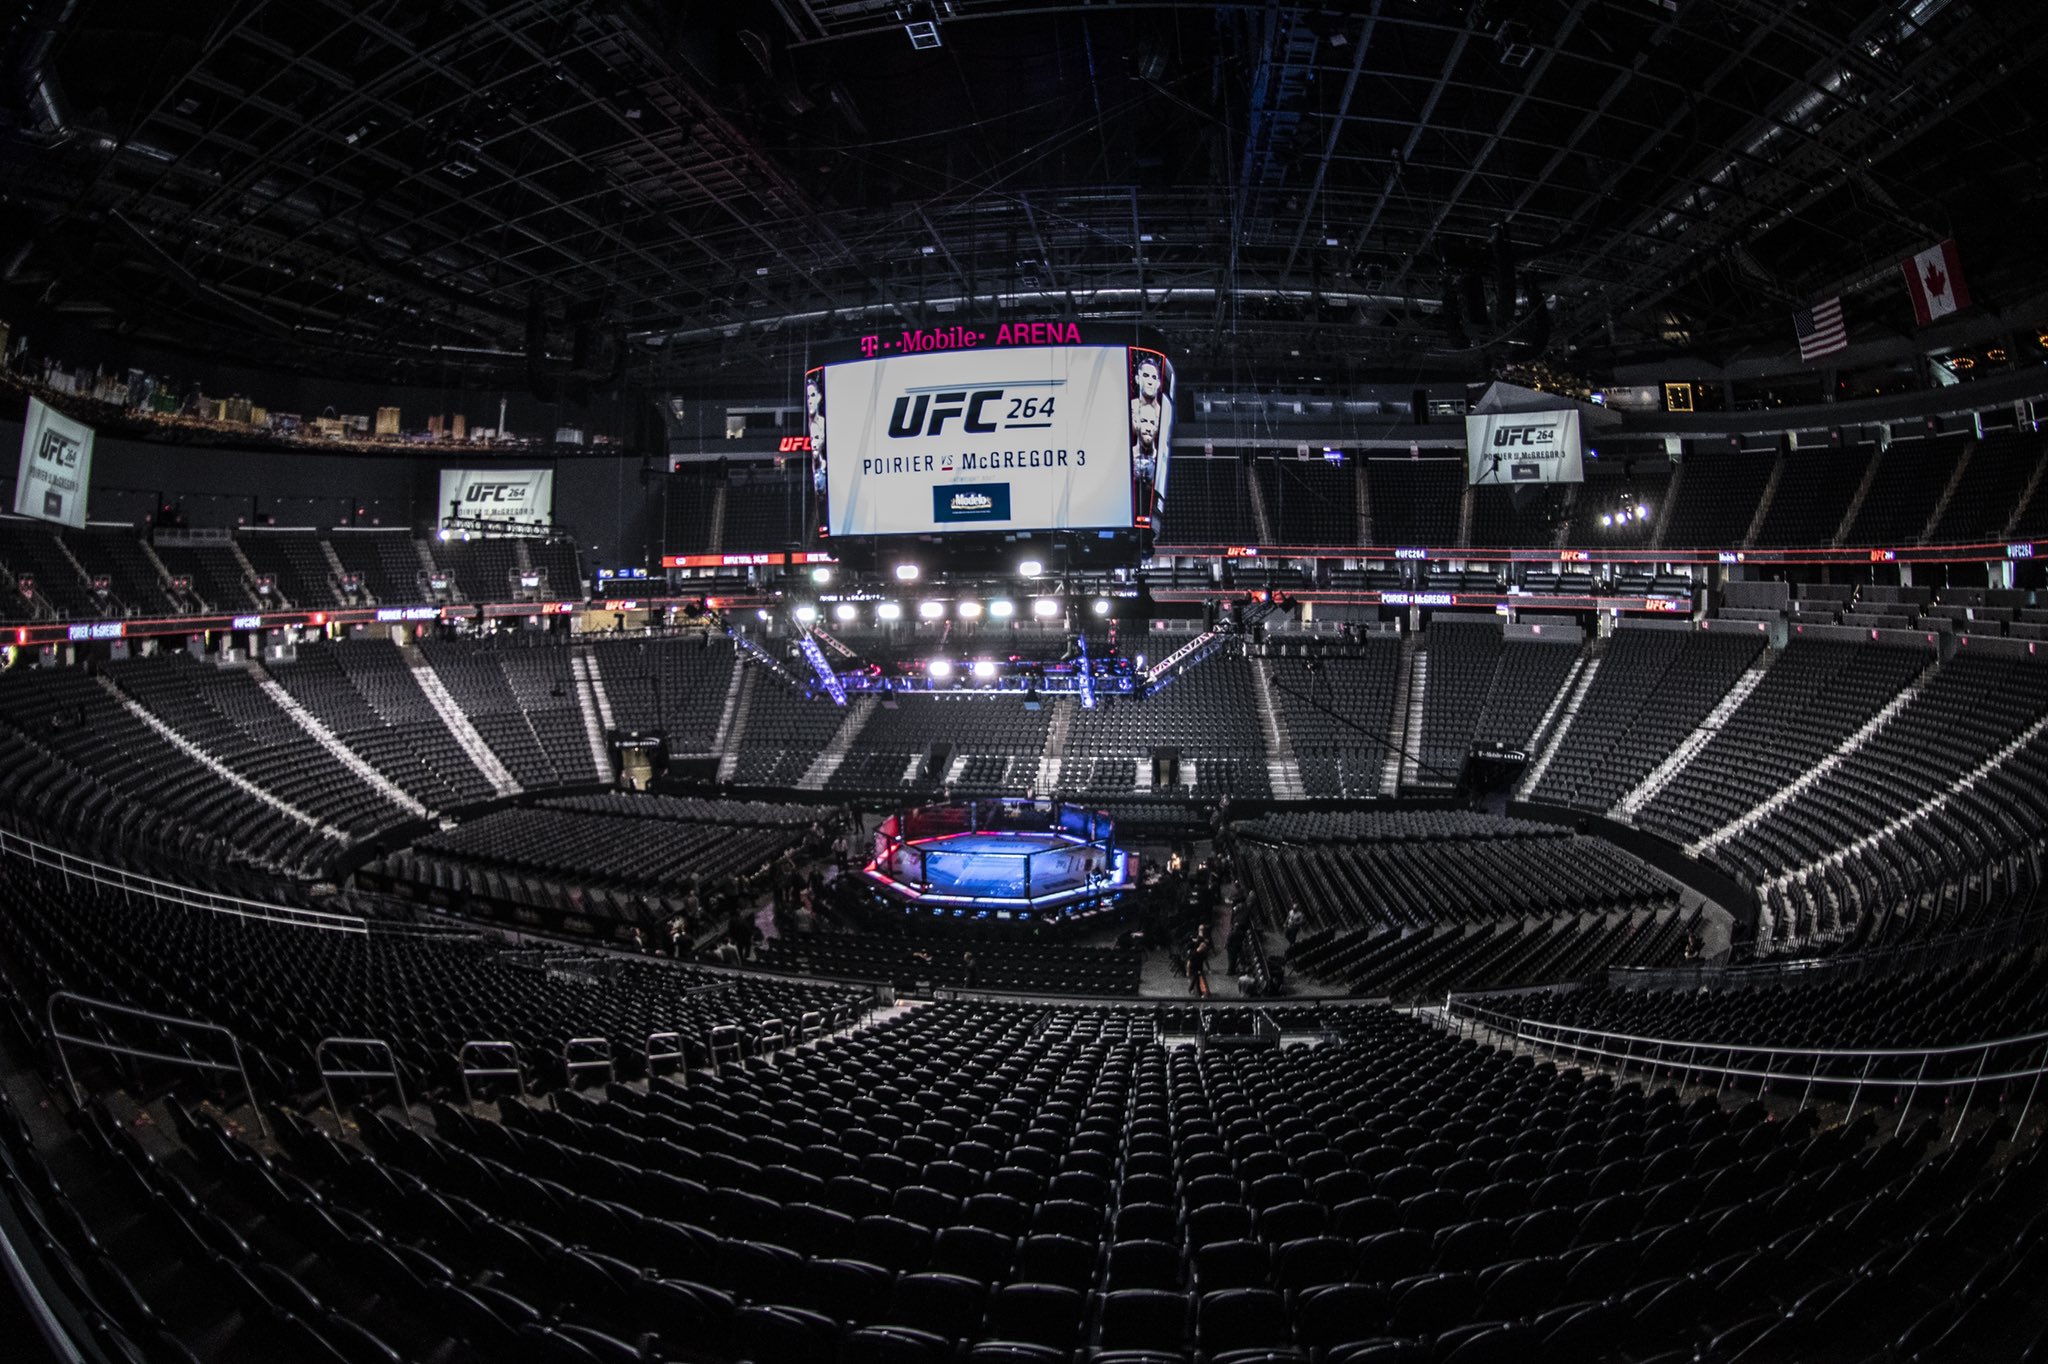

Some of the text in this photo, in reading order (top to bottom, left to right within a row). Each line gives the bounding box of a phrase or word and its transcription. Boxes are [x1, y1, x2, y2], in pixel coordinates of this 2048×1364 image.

[996, 322, 1082, 345] ARENA
[888, 390, 1055, 439] UFC 264
[1494, 428, 1554, 447] UFC 264
[39, 431, 77, 467] UFC 264
[863, 455, 934, 475] POIRIER
[962, 450, 1068, 470] McGREGOR
[1077, 450, 1086, 466] 3
[465, 486, 526, 503] UFC 264
[1228, 547, 1248, 556] UFC
[1561, 551, 1579, 560] UFC
[1871, 551, 1886, 562] UFC
[542, 603, 562, 613] UFC
[605, 601, 625, 611] UFC
[1646, 600, 1666, 610] UFC
